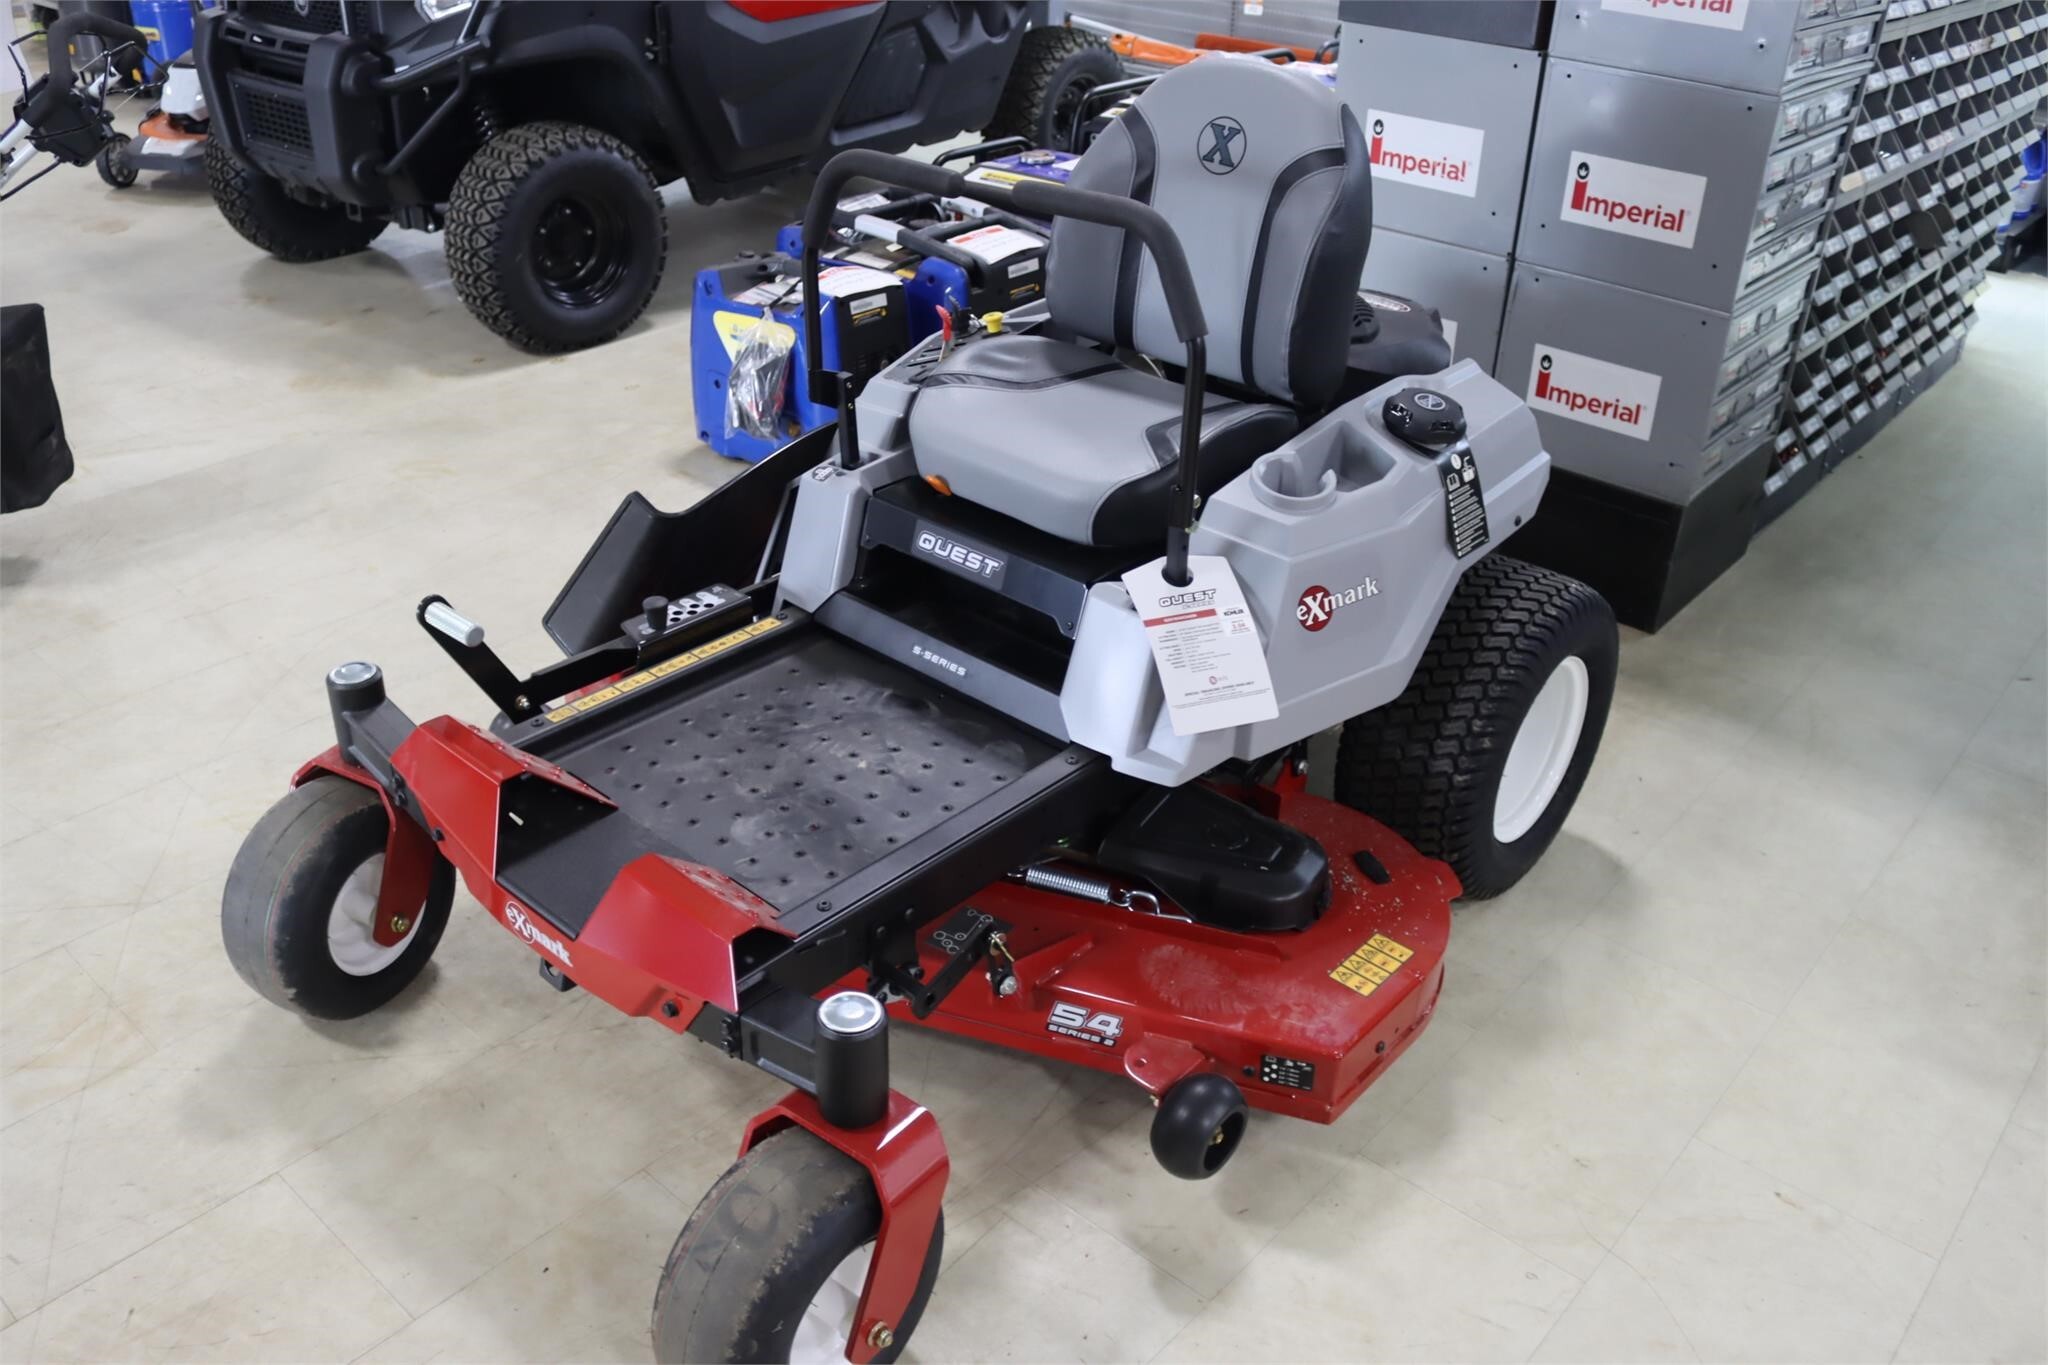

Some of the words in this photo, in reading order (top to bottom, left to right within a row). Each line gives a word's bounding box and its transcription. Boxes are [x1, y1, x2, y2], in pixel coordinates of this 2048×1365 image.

[917, 531, 1002, 576] QUEST
[1159, 588, 1216, 607] QUEST
[1049, 1002, 1123, 1037] 54
[1048, 1024, 1101, 1043] SERIES
